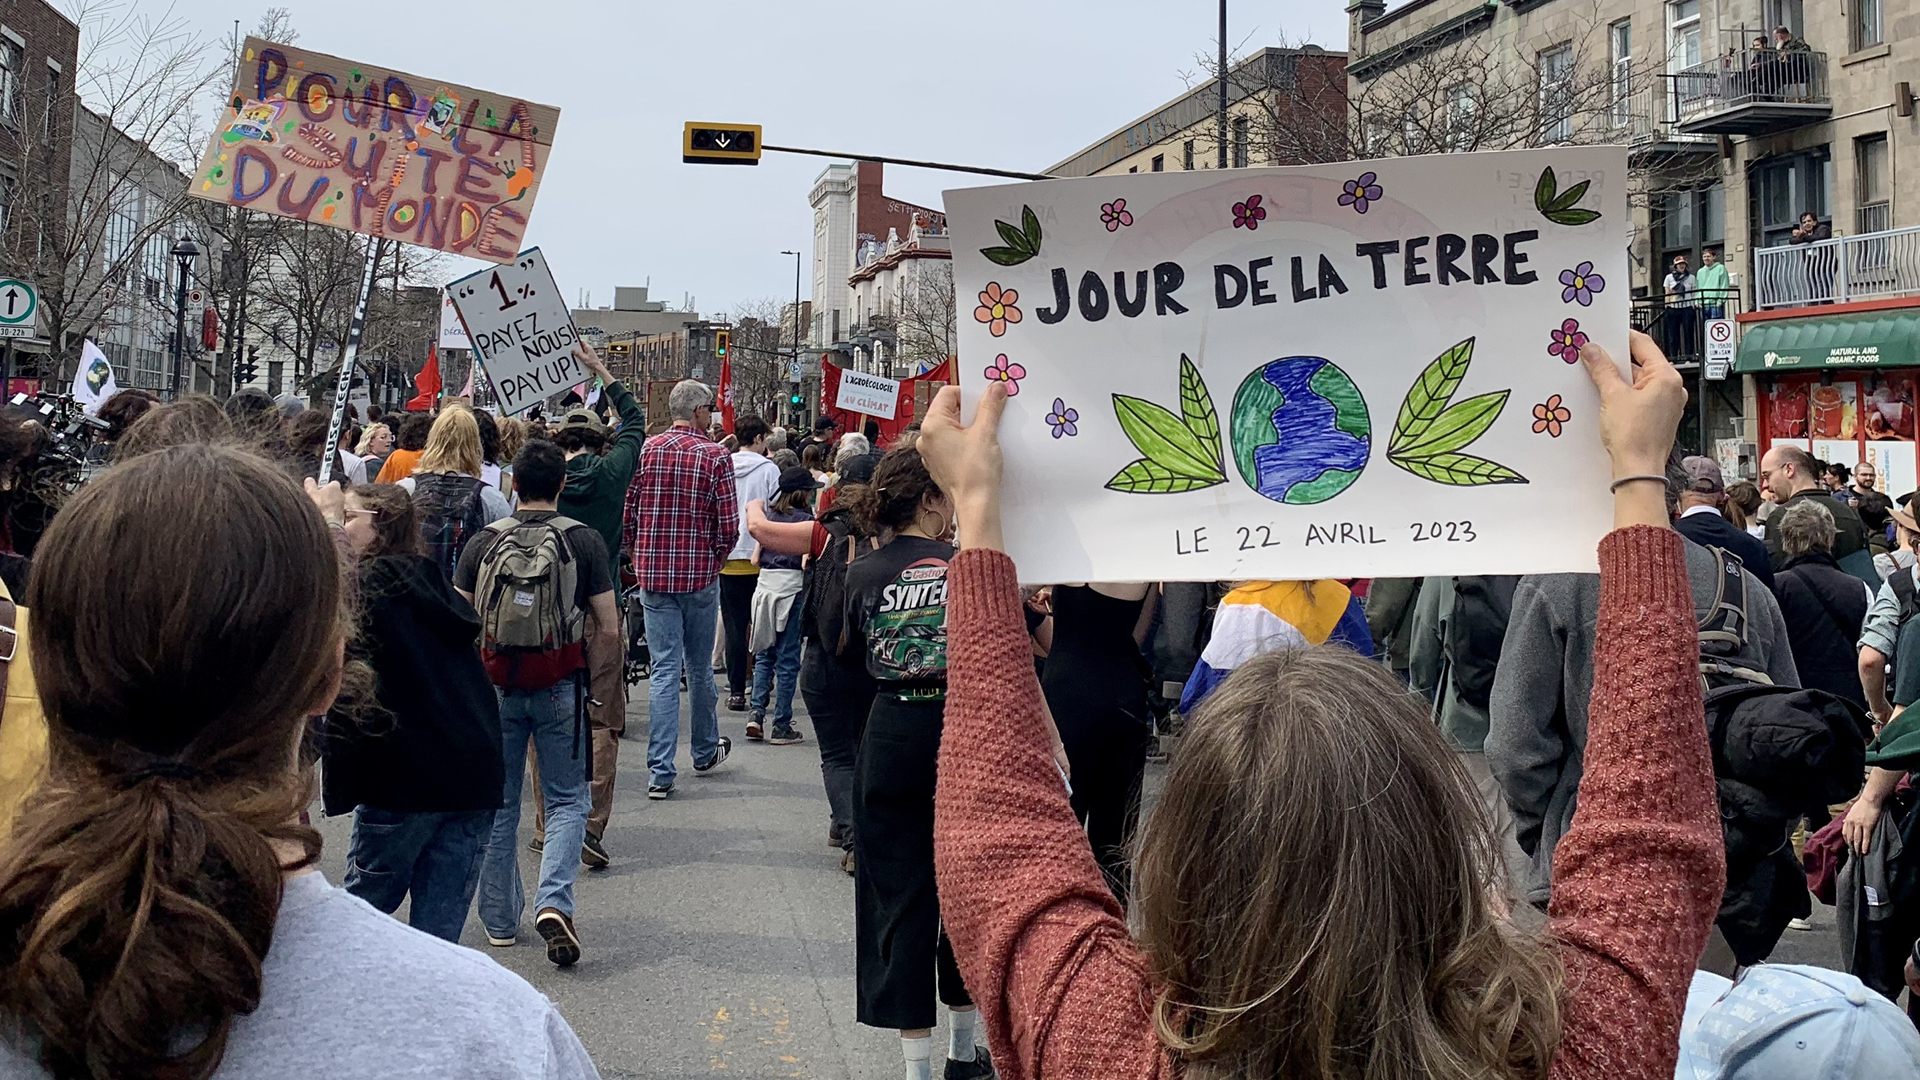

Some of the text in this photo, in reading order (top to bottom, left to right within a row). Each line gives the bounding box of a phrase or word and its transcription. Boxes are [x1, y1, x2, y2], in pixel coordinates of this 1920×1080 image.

[257, 48, 536, 172] POUR LA
[229, 145, 526, 260] DU MONDE
[1036, 230, 1539, 324] JOUR DE LA TERRE
[475, 312, 545, 359] PAYEZ
[521, 324, 578, 363] NOUS!
[1825, 355, 1880, 364] ORGANIC FOODS
[1830, 347, 1877, 356] NATURAL AND
[500, 353, 582, 406] PAY UP!
[325, 371, 351, 462] FUSE-TECH
[1176, 520, 1477, 555] LE 22 AVRIL 2023
